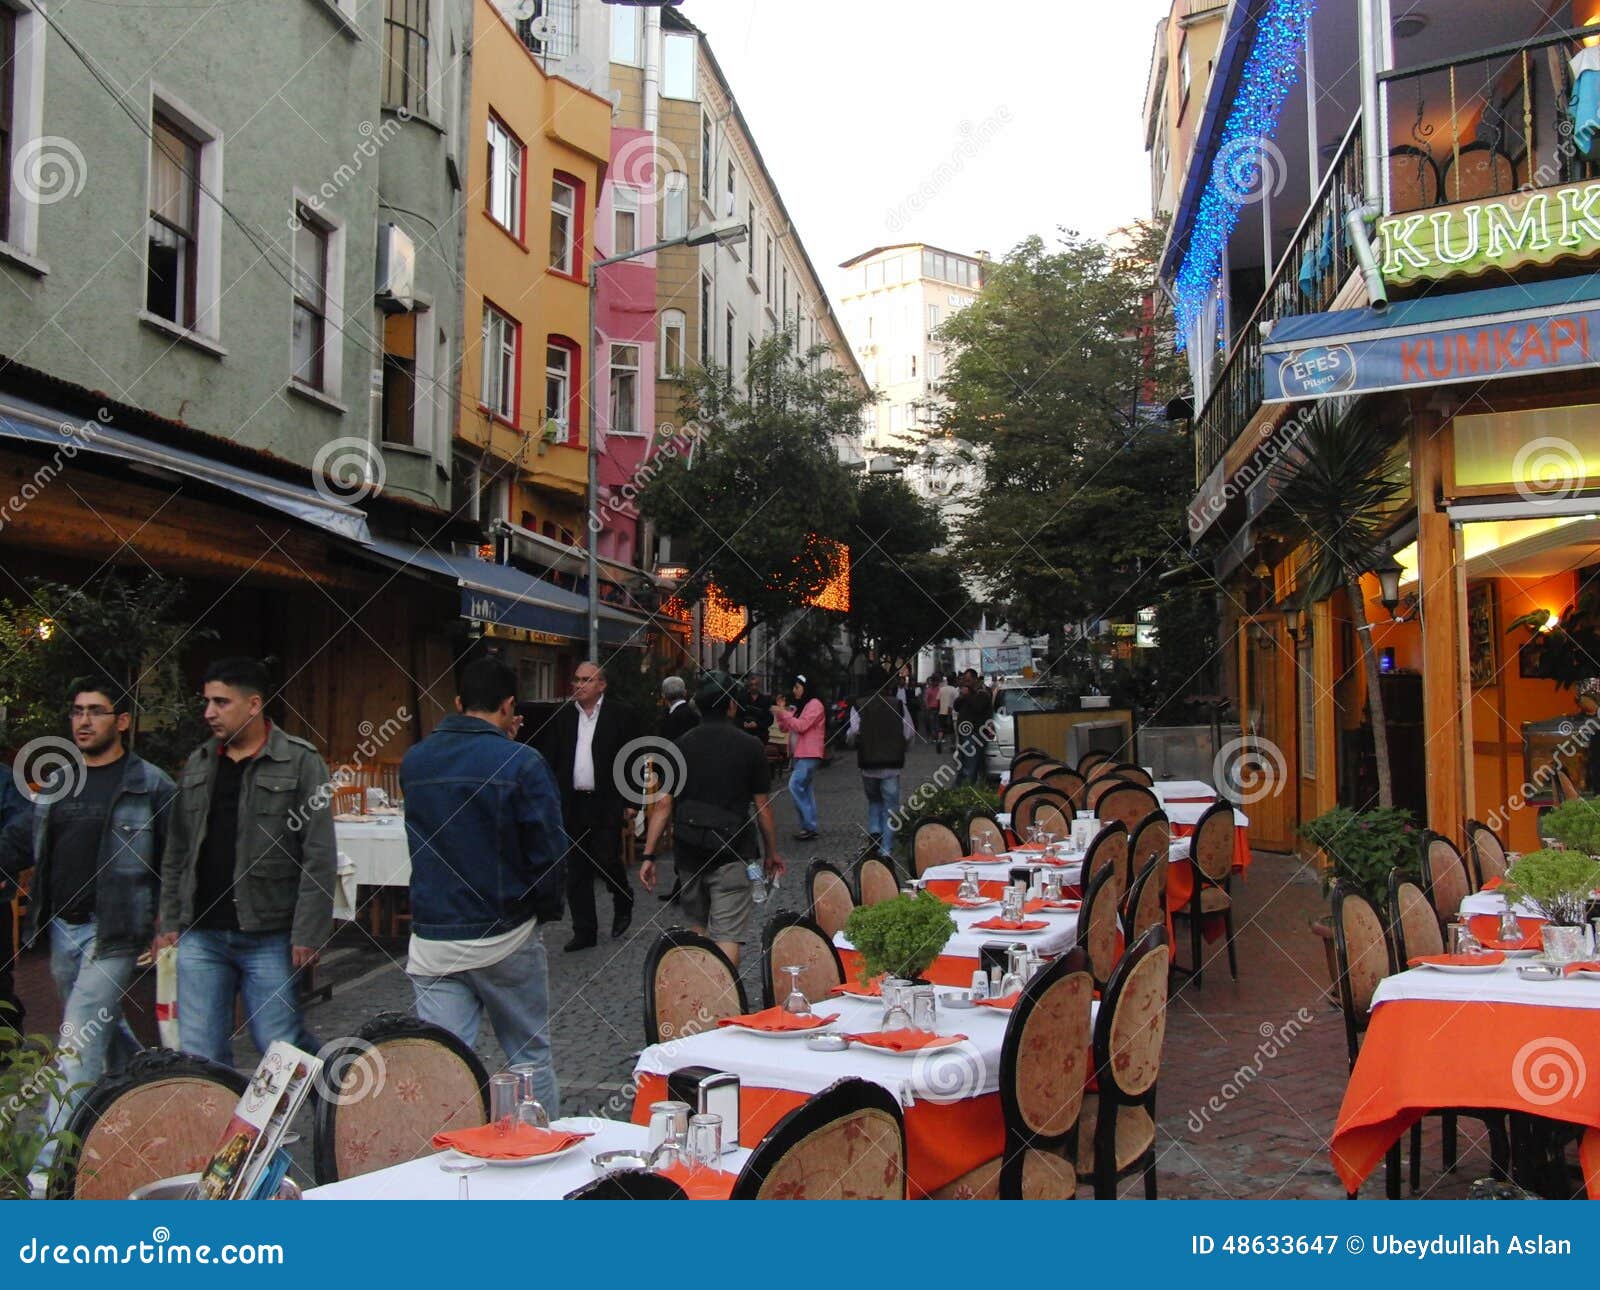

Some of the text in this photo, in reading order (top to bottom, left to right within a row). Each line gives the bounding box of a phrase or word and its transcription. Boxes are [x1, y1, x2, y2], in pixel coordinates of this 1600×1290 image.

[1401, 316, 1590, 382] KUMKAPI
[1292, 351, 1341, 380] EFES
[1303, 374, 1335, 391] Pilsen
